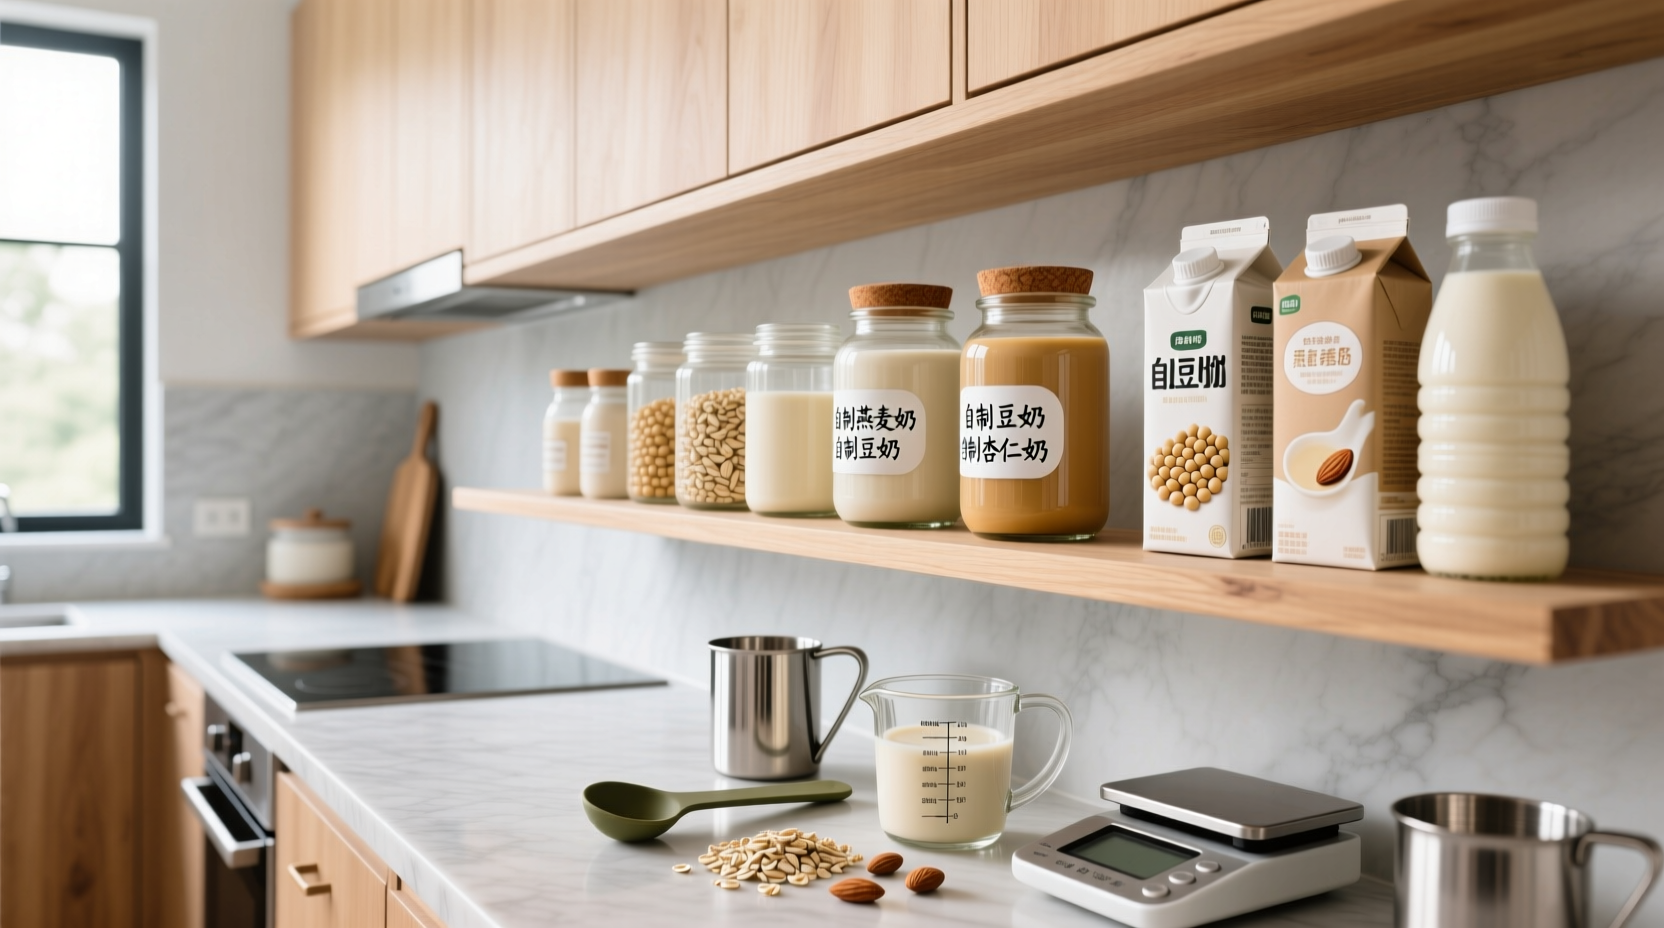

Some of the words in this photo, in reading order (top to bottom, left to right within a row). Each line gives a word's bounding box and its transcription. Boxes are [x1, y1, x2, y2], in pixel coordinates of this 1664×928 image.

[835, 404, 917, 431] 自制燕麦奶
[965, 403, 1046, 431] 自制豆奶
[835, 436, 901, 461] 自制豆奶
[961, 435, 1049, 463] 自制杏仁奶
